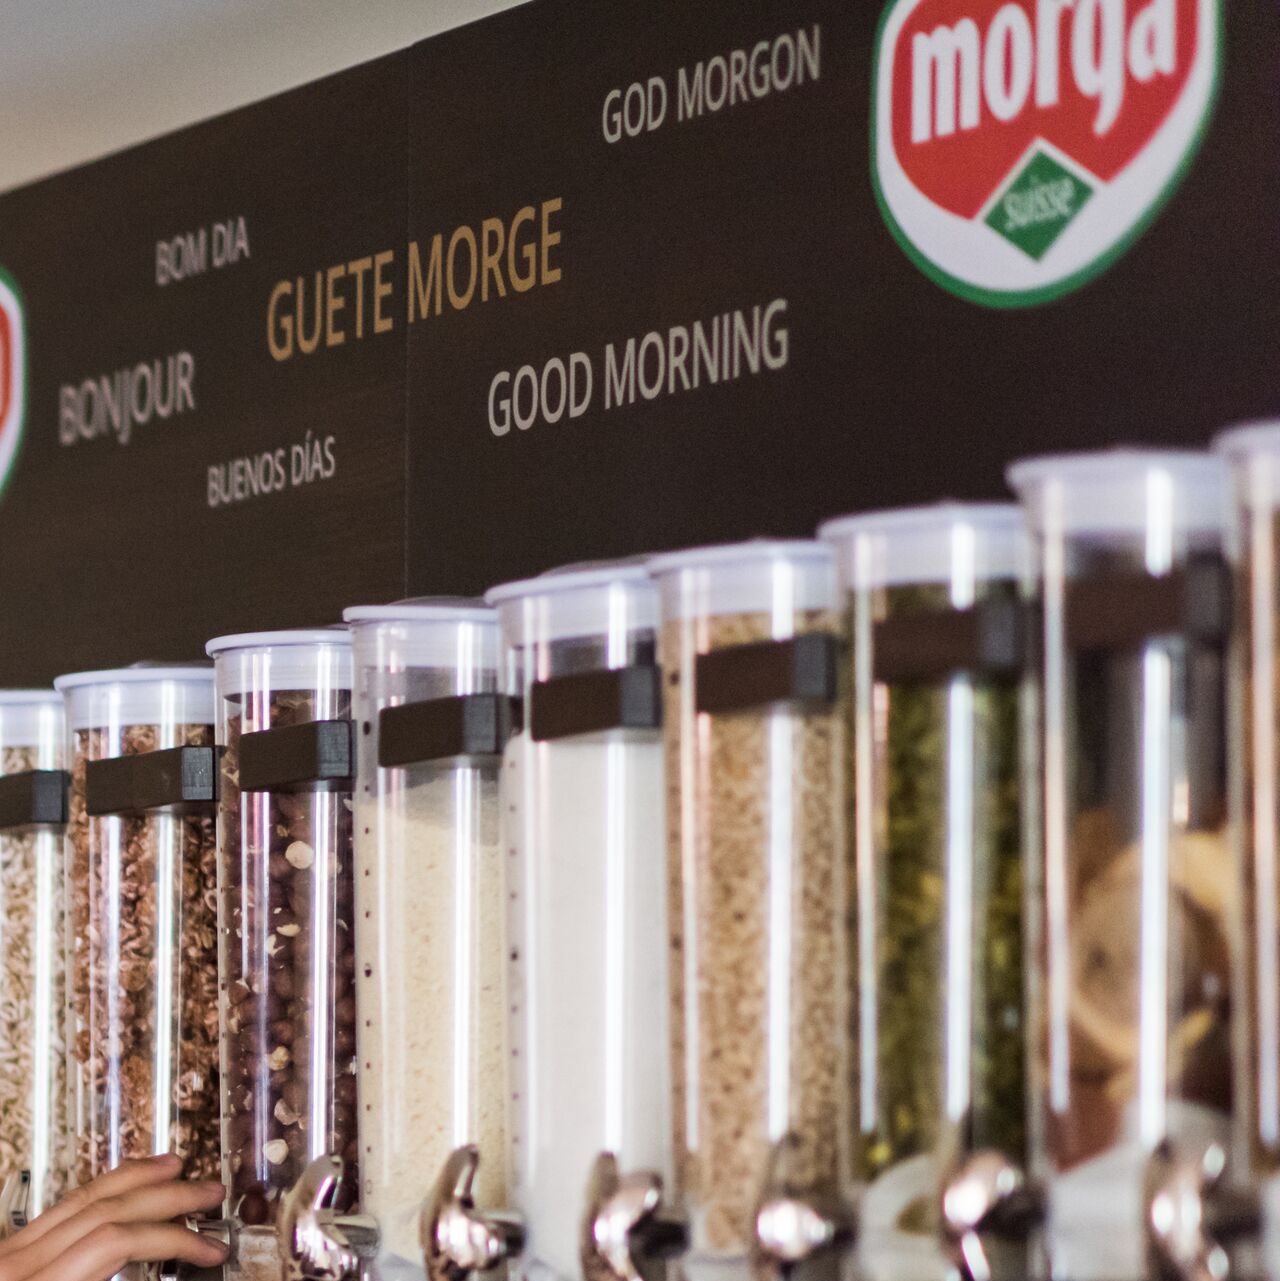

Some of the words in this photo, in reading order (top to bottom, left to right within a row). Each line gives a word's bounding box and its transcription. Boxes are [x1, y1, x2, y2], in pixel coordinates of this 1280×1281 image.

[602, 76, 667, 144] GOD
[677, 24, 821, 123] MORGON
[911, 0, 1177, 144] morga
[155, 228, 207, 287] BOM
[212, 216, 251, 269] DIA
[267, 250, 394, 362] GUETE
[408, 197, 563, 324] MORGE
[58, 350, 196, 447] BONJOUR
[488, 352, 593, 438] GOOD
[603, 298, 789, 411] MORNING
[207, 448, 286, 508] BUENOS
[292, 429, 336, 488] DÍAS
